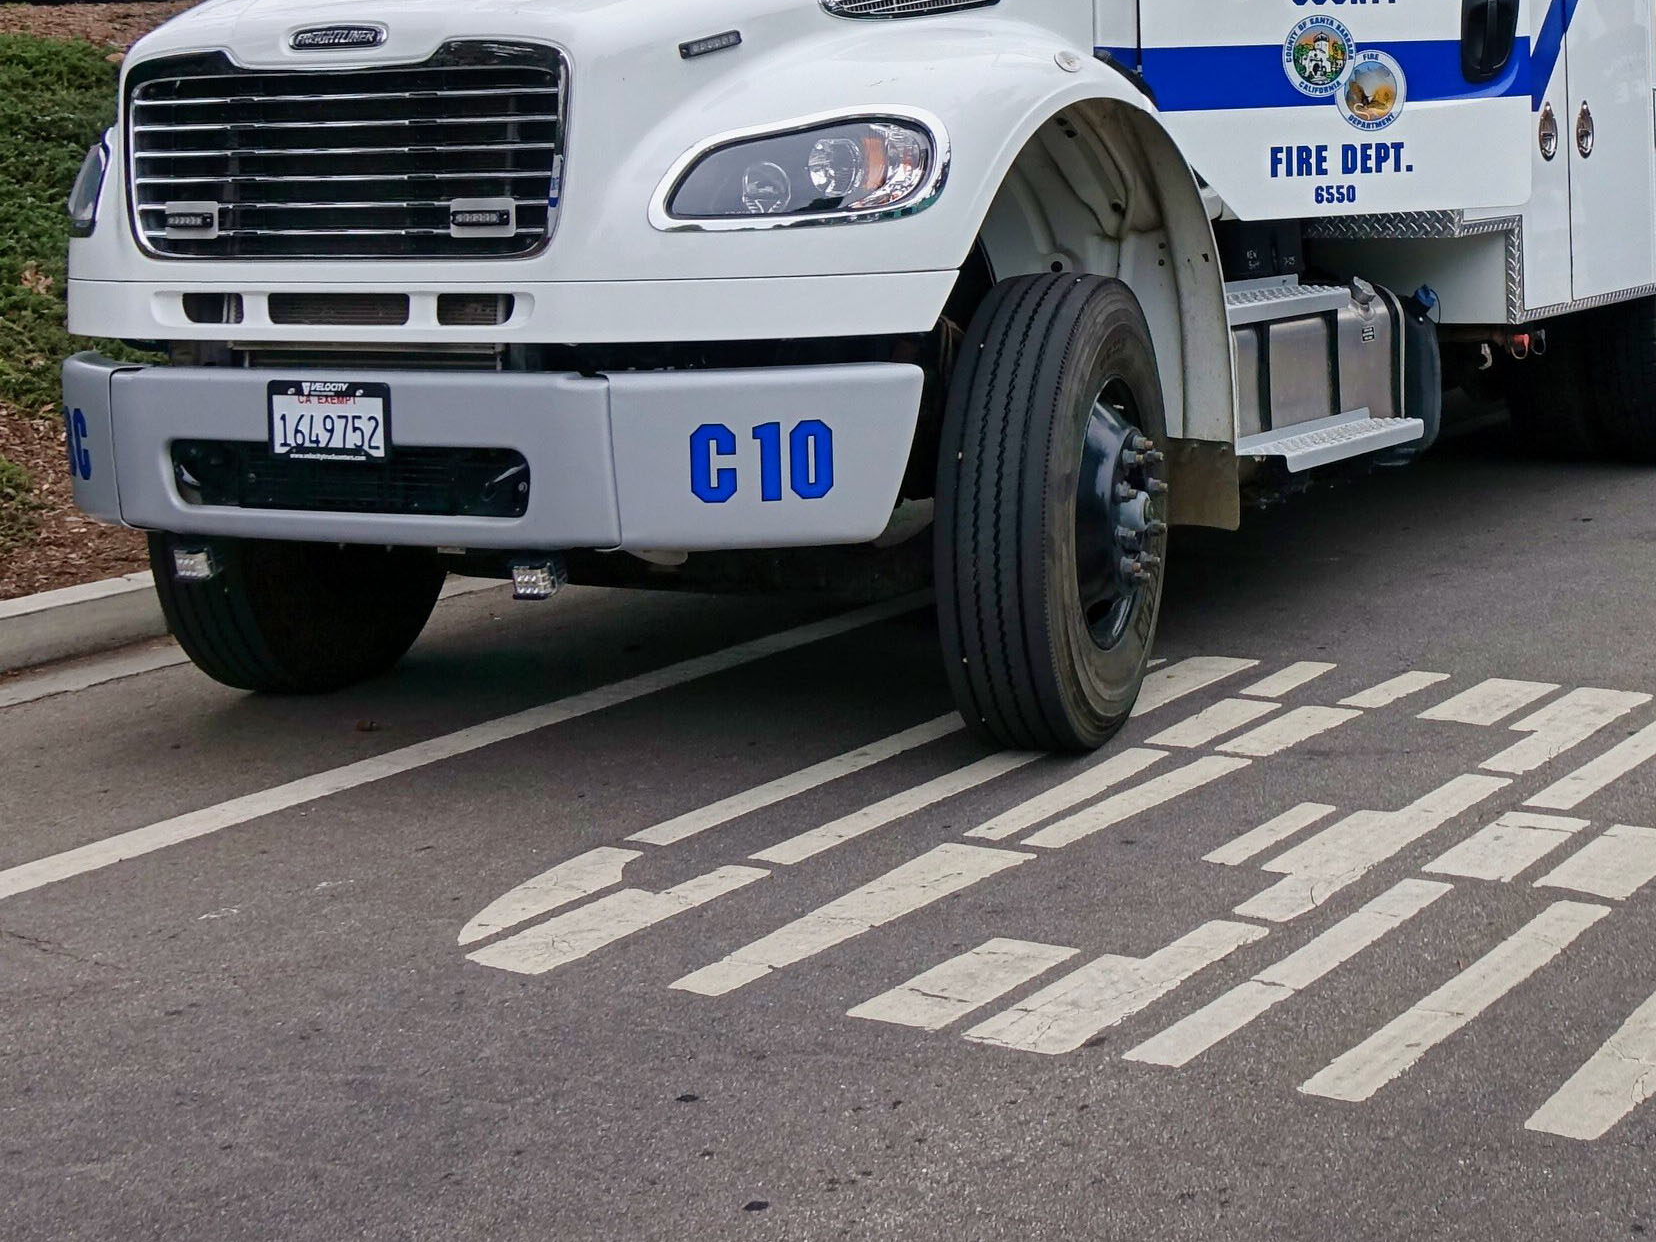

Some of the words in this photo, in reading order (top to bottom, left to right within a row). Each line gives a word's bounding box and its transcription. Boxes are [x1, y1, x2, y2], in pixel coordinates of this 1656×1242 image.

[296, 29, 375, 44] FREIGHTLINER
[1286, 31, 1298, 62] COUNTY
[1298, 21, 1307, 31] OF
[1310, 17, 1334, 27] SANTA
[1336, 23, 1354, 61] BARBARA
[1362, 53, 1380, 61] FIRE
[1299, 80, 1342, 94] CALIFORNIA
[1348, 113, 1395, 129] DEPARTMENT
[1270, 145, 1328, 178] FIRE
[1342, 142, 1413, 174] DEPT.
[1314, 185, 1356, 204] 6550
[310, 383, 349, 392] VELOCITY
[280, 413, 380, 450] 1649752
